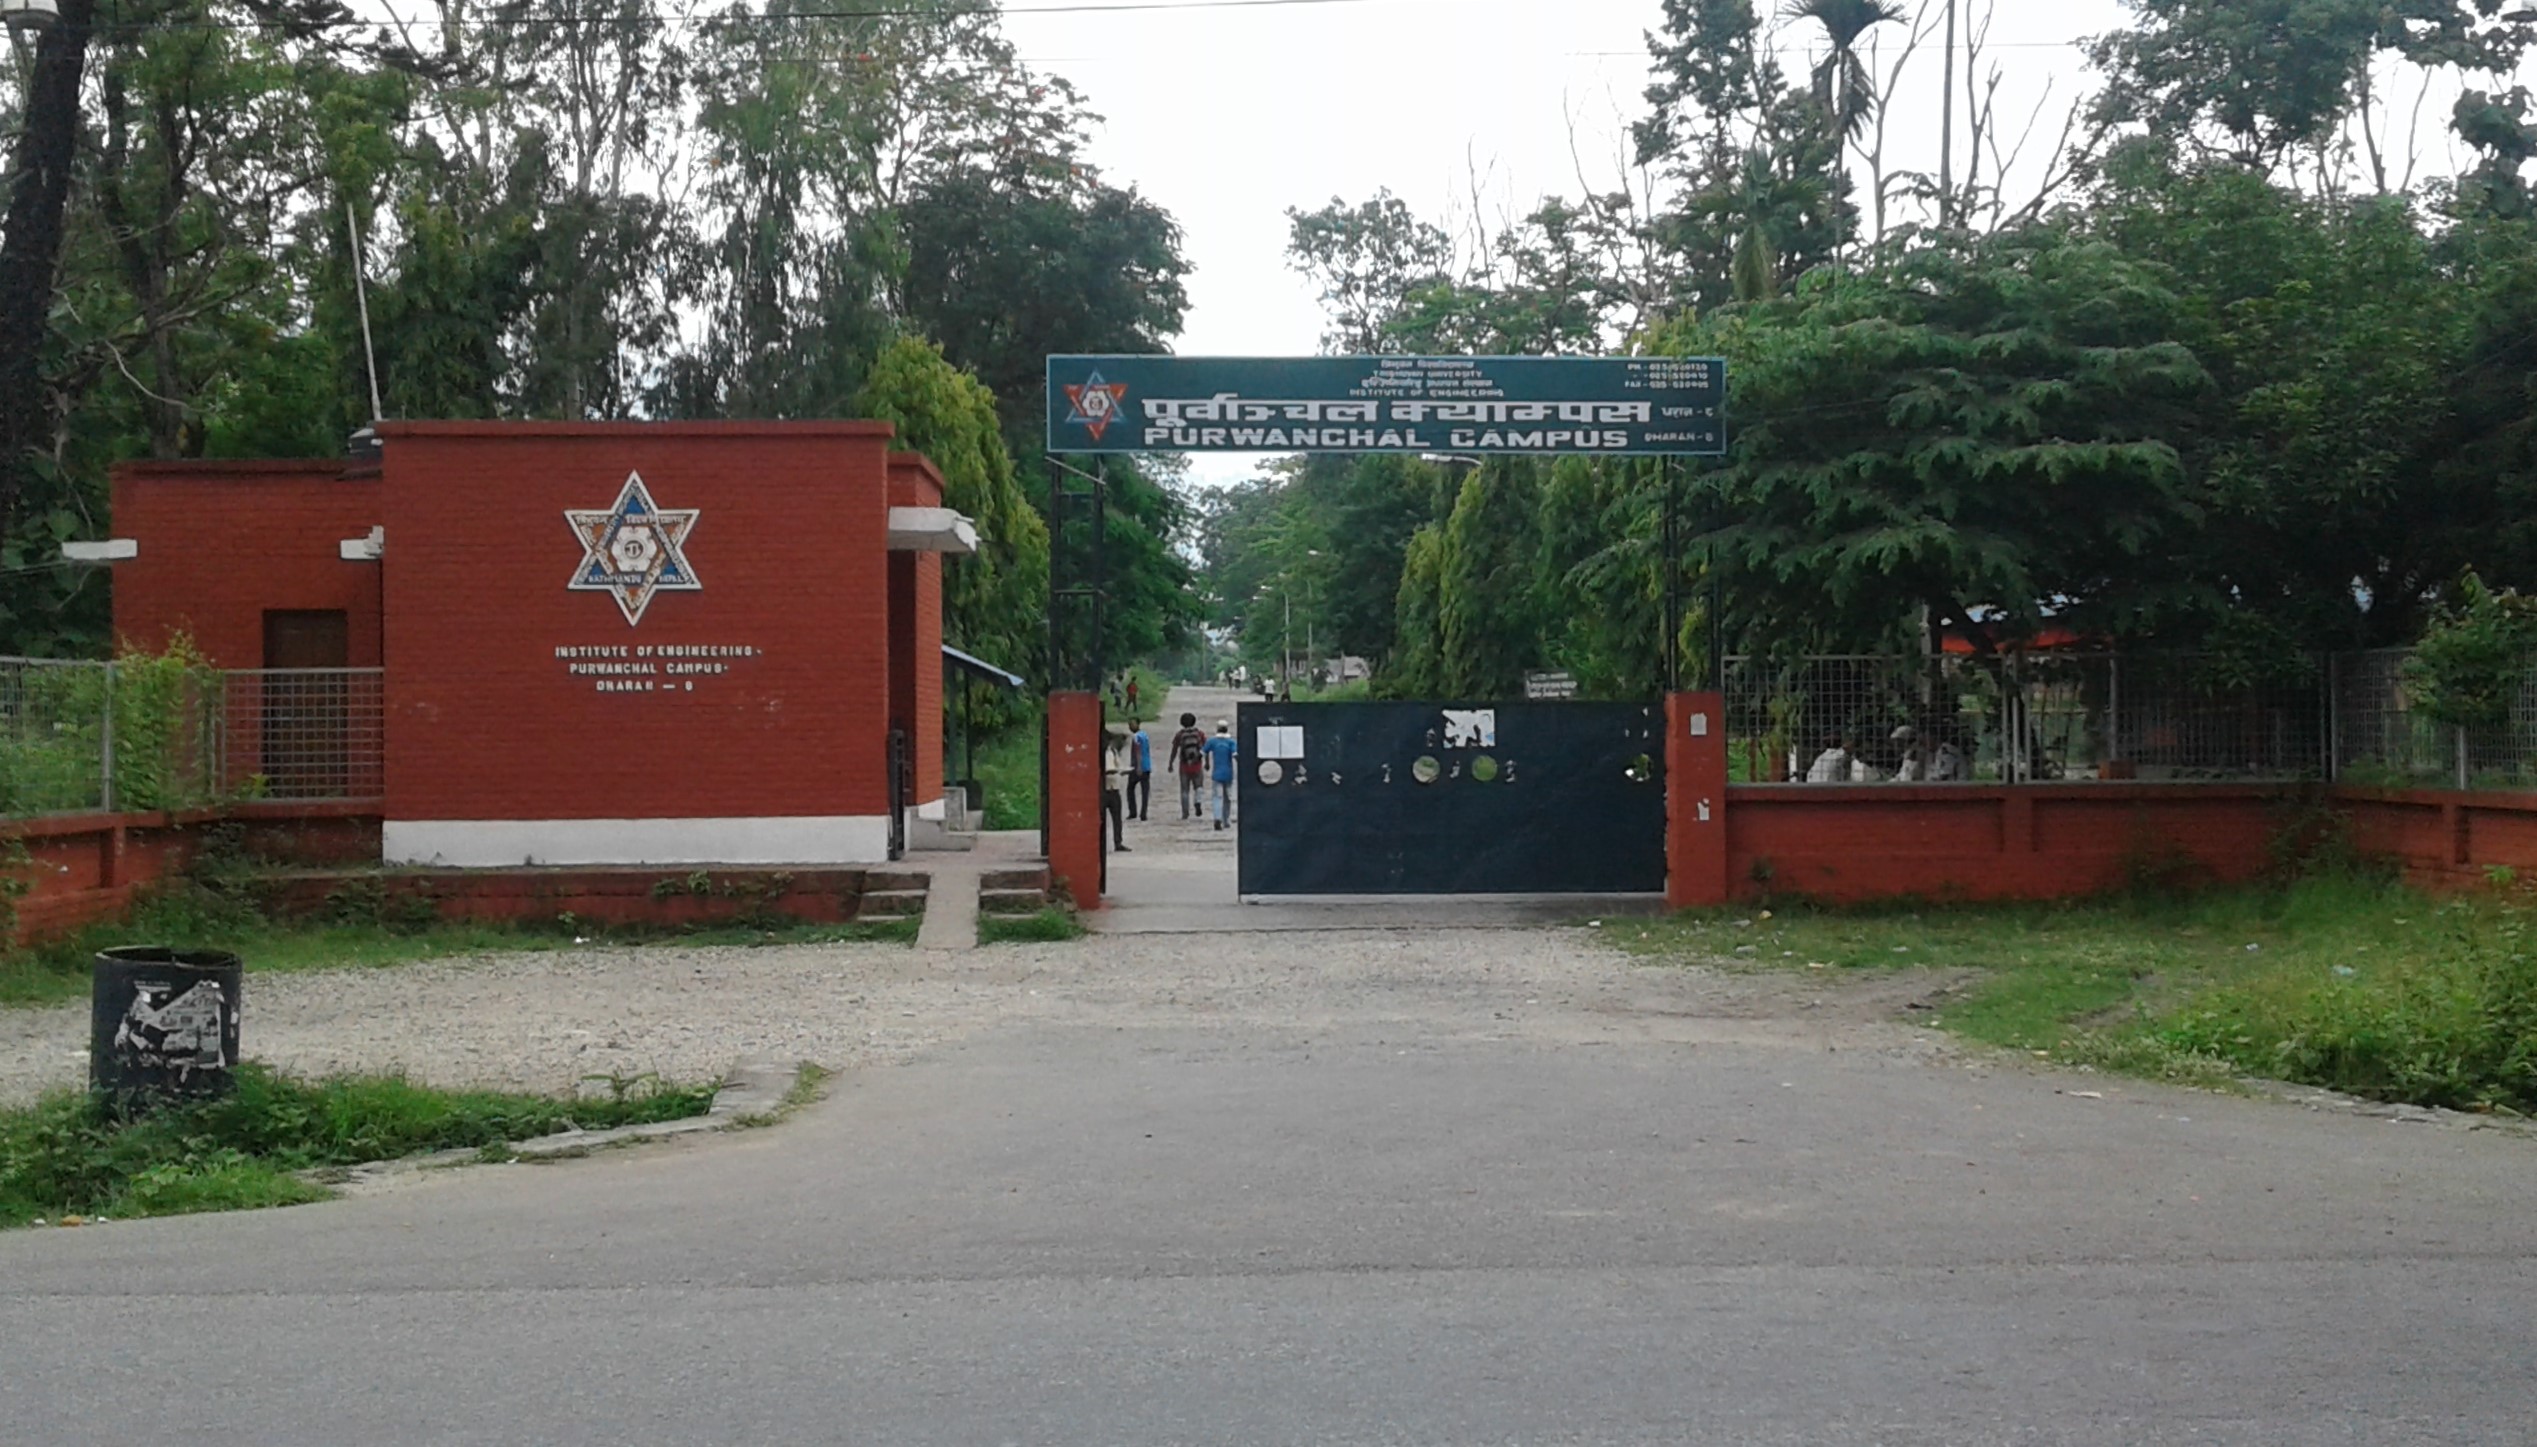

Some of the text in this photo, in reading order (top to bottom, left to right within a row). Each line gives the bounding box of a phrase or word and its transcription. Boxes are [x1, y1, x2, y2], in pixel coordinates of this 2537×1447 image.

[1144, 427, 1628, 447] PURWANCHAL CAMPUS
[1644, 432, 1695, 442] DHARAN
[555, 646, 628, 658] INSTITUTE
[637, 646, 653, 656] OF
[569, 663, 657, 674] PURWANCHAL
[596, 680, 653, 691] DHARAN
